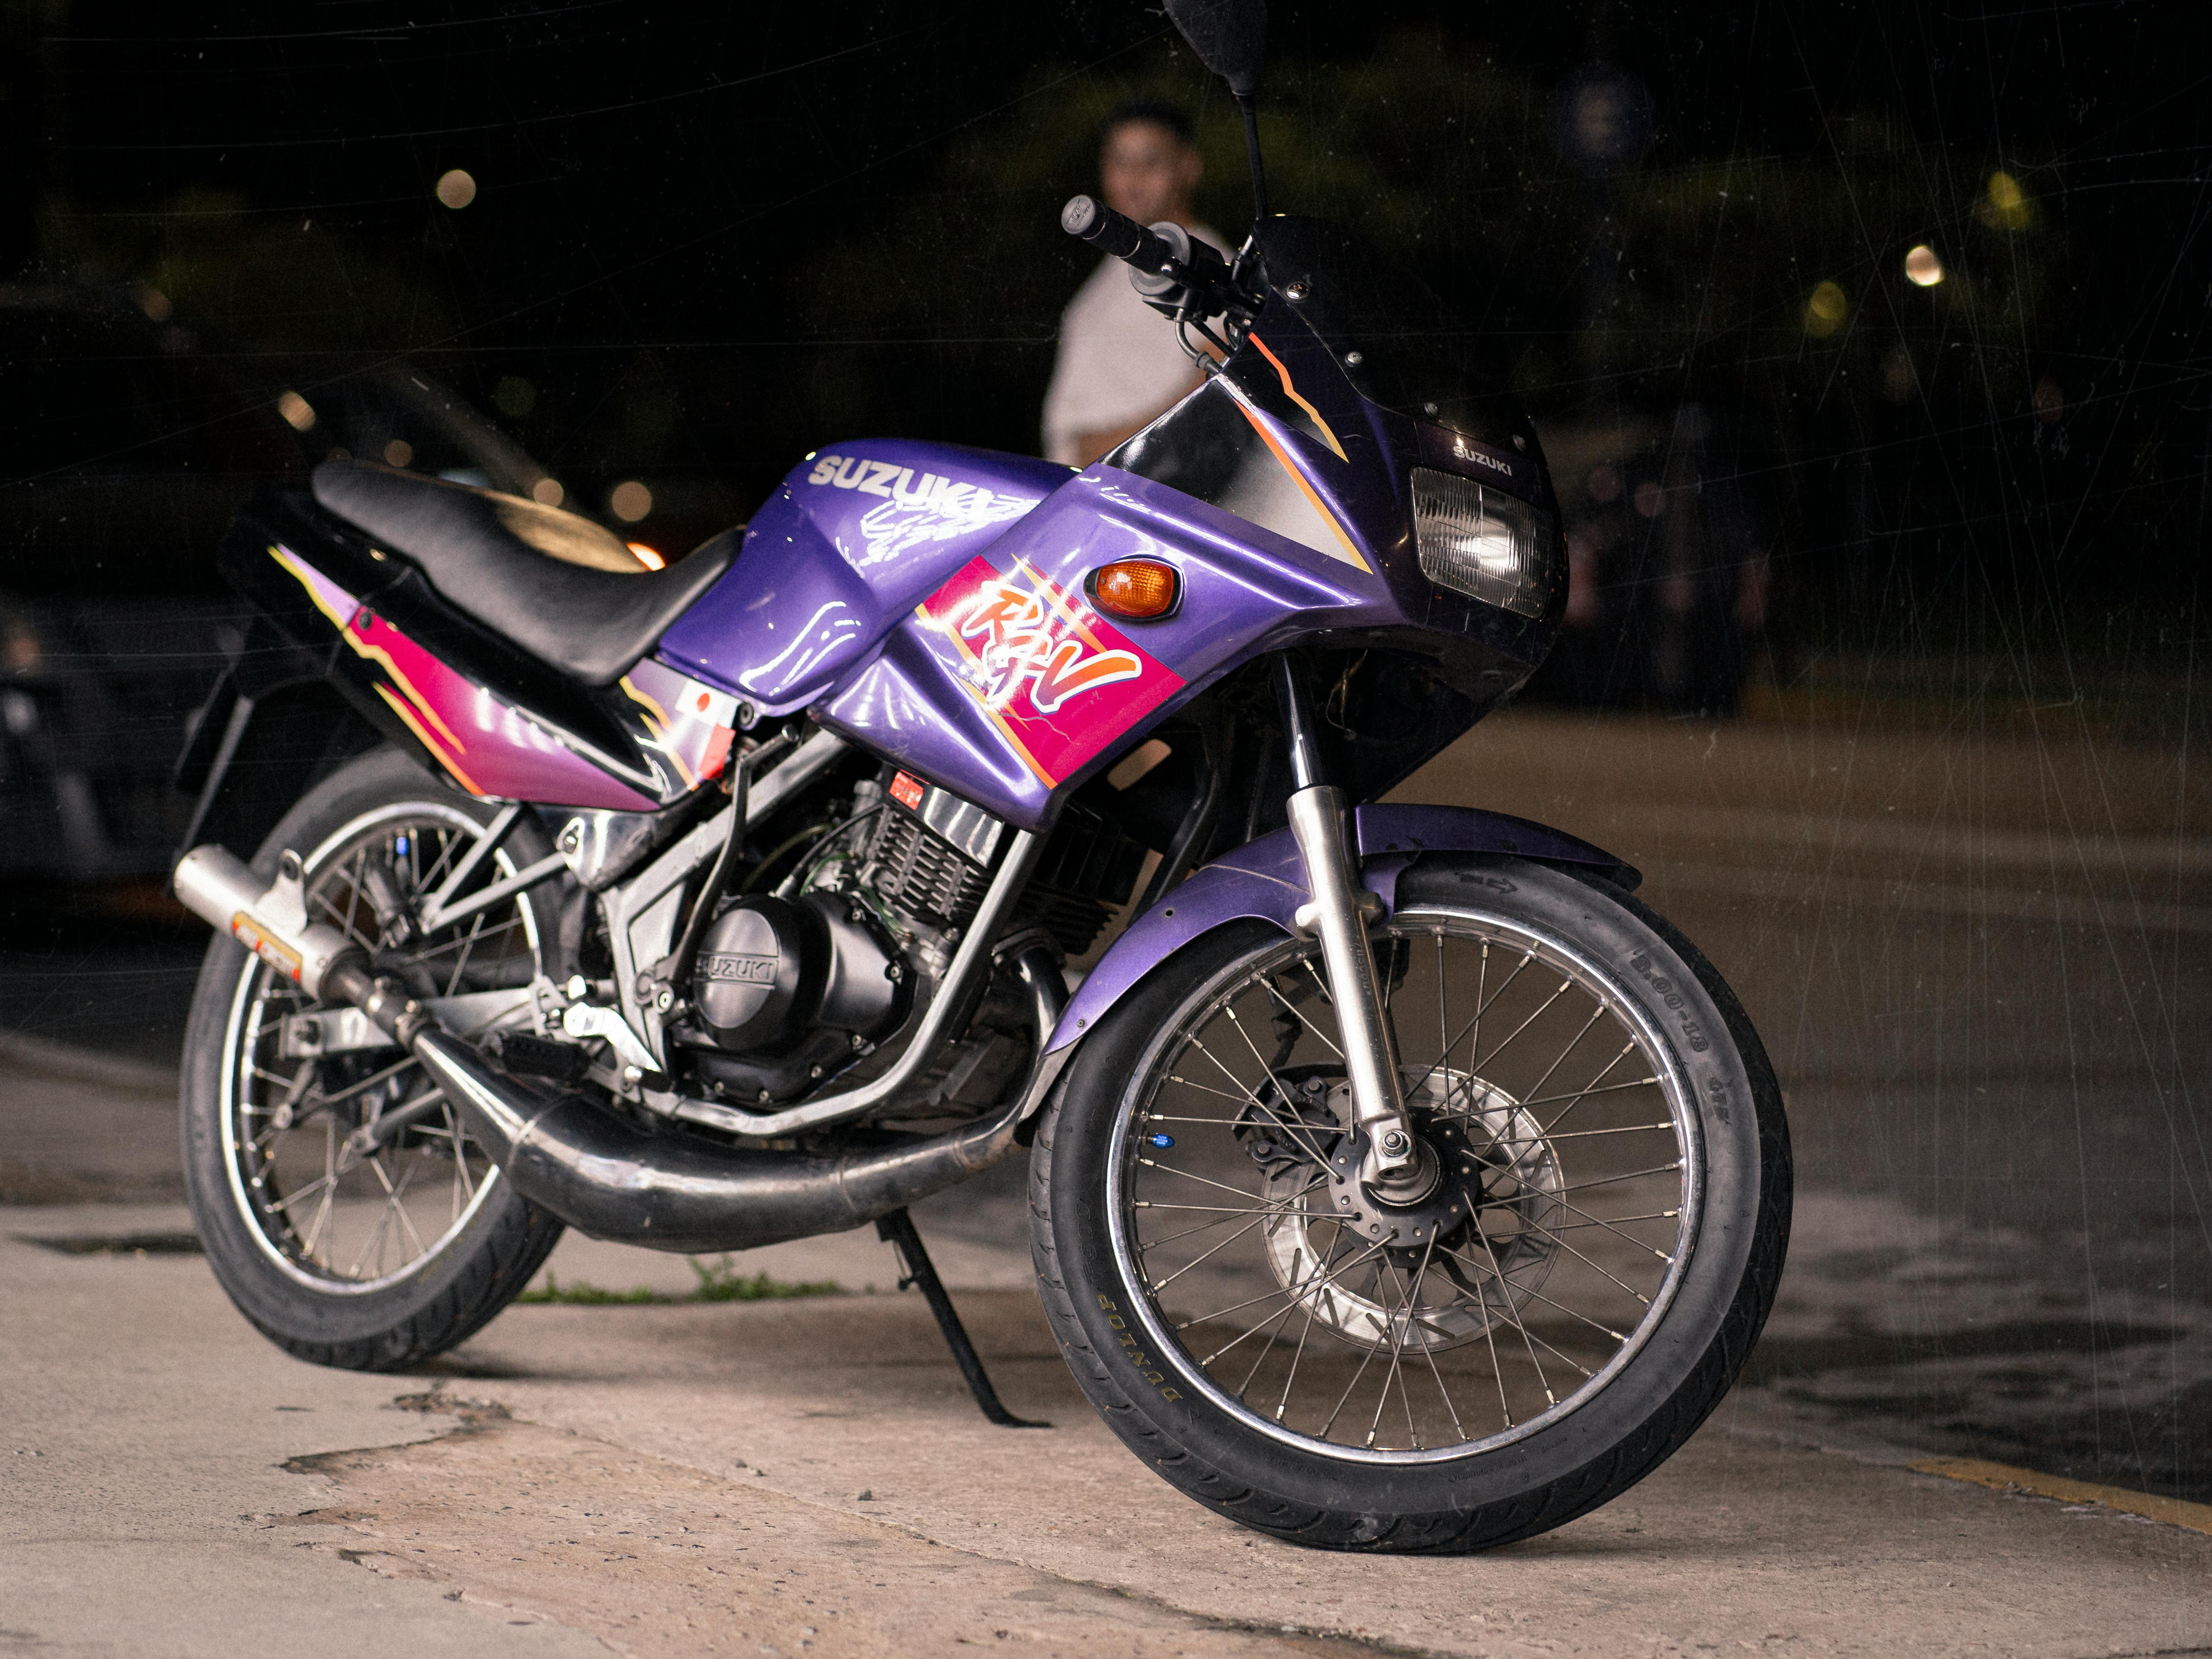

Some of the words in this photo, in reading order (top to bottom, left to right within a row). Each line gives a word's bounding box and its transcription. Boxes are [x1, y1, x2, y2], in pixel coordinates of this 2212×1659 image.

[808, 455, 994, 521] SUZUKI
[1454, 445, 1512, 477] SUZUKI
[1630, 955, 1708, 1052] 3.00-18
[1096, 1294, 1183, 1402] DUNLOP
